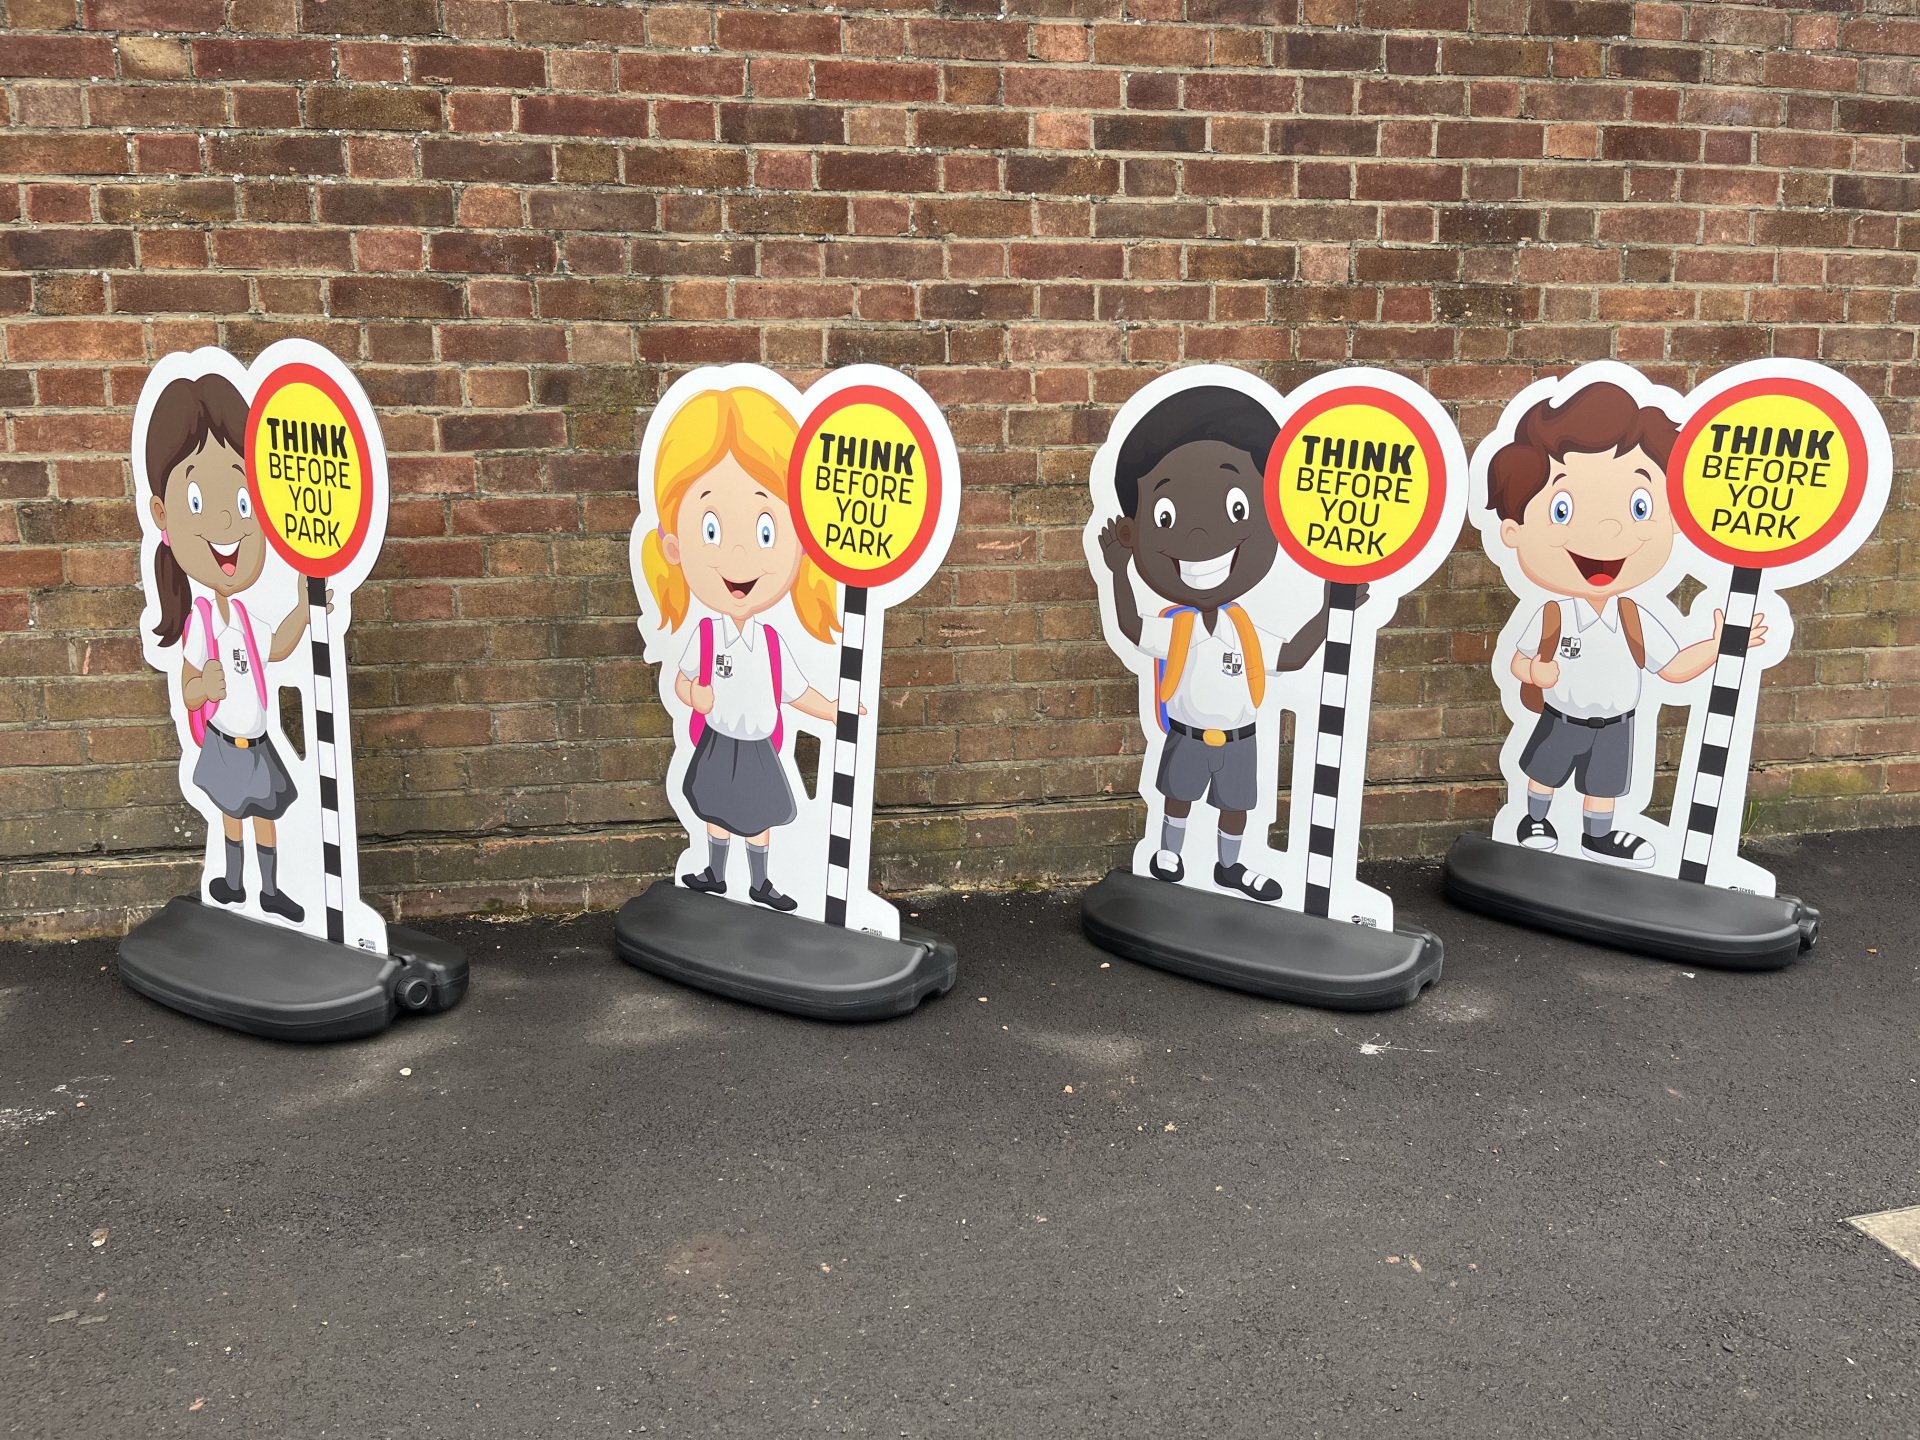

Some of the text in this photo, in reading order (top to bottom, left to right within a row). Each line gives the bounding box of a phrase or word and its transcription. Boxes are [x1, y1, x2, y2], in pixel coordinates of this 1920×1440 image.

[266, 417, 348, 459] THINK
[819, 433, 915, 476] THINK
[1302, 435, 1415, 476] THINK
[1710, 424, 1835, 460] THINK
[268, 452, 351, 490] BEFORE
[816, 465, 914, 505] BEFORE
[1296, 467, 1413, 504] BEFORE
[1702, 455, 1831, 487] BEFORE
[288, 484, 332, 516] YOU
[836, 496, 887, 528] YOU
[1320, 496, 1380, 527] YOU
[1728, 483, 1794, 511] YOU
[285, 513, 342, 548] PARK
[825, 523, 893, 559] PARK
[1307, 523, 1387, 557] PARK
[1711, 508, 1800, 540] PARK
